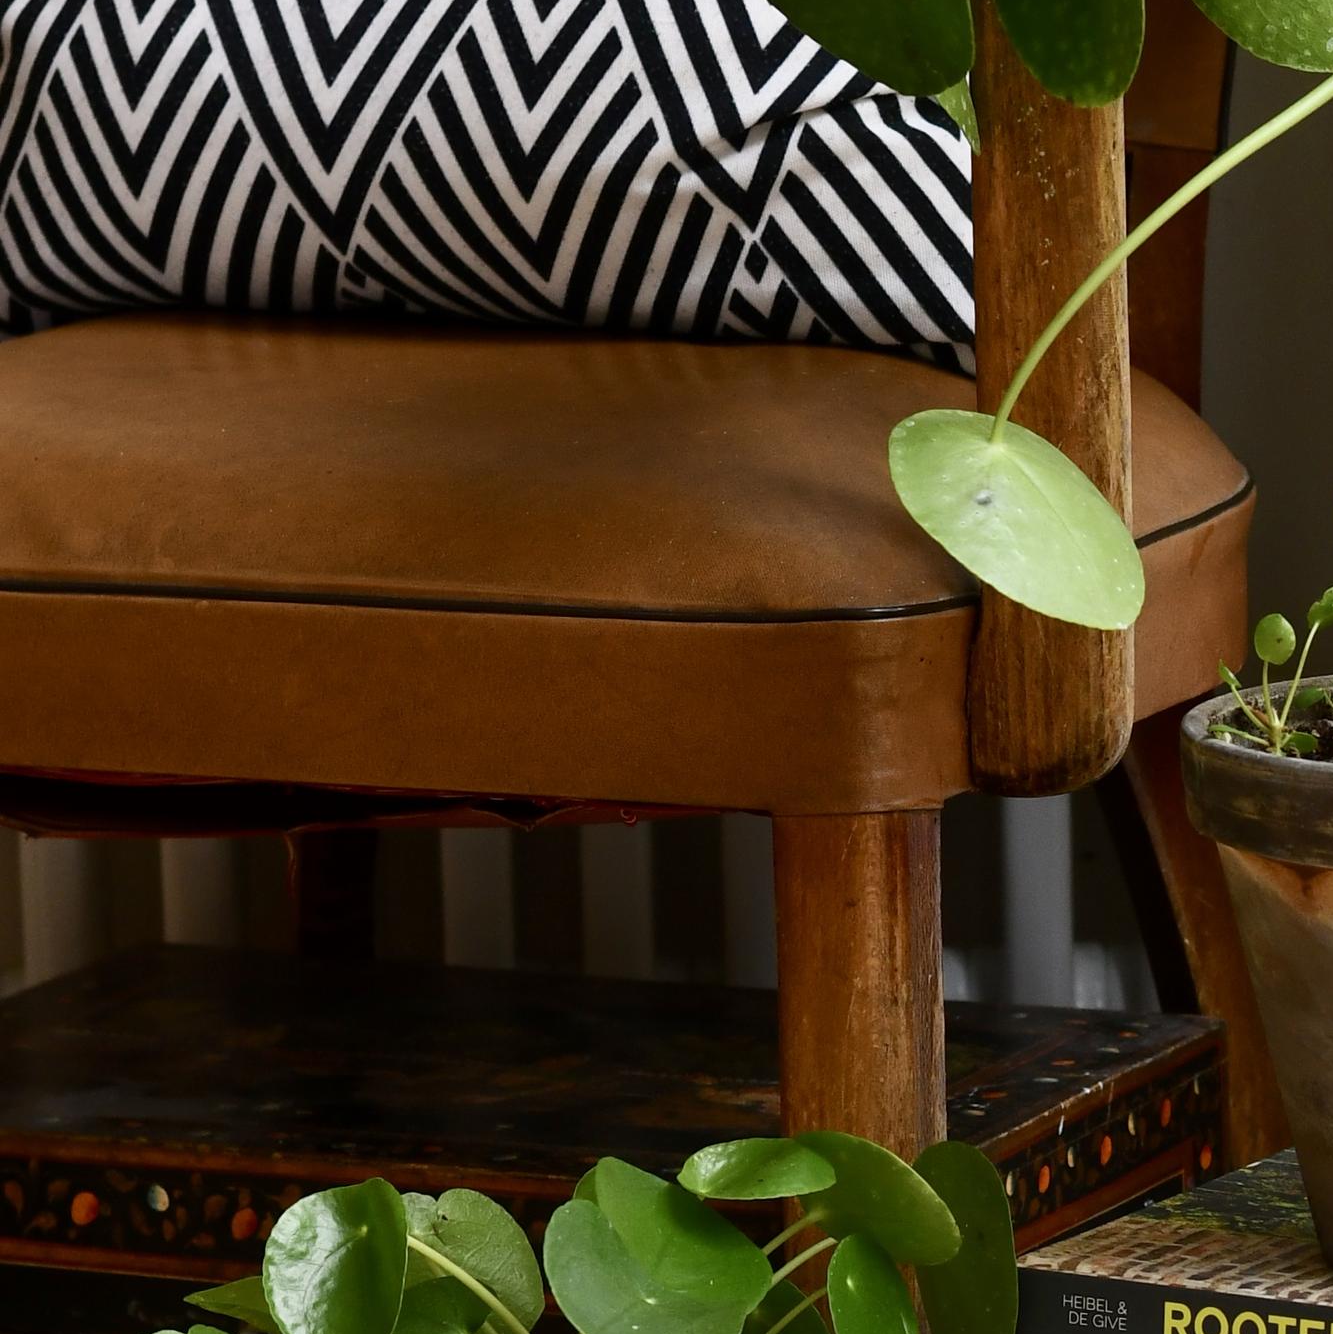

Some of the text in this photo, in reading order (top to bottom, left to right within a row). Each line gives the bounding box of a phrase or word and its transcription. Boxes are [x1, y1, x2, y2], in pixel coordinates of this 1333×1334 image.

[1062, 1294, 1128, 1315] HEIBEL &
[1068, 1311, 1128, 1332] DE GIVE
